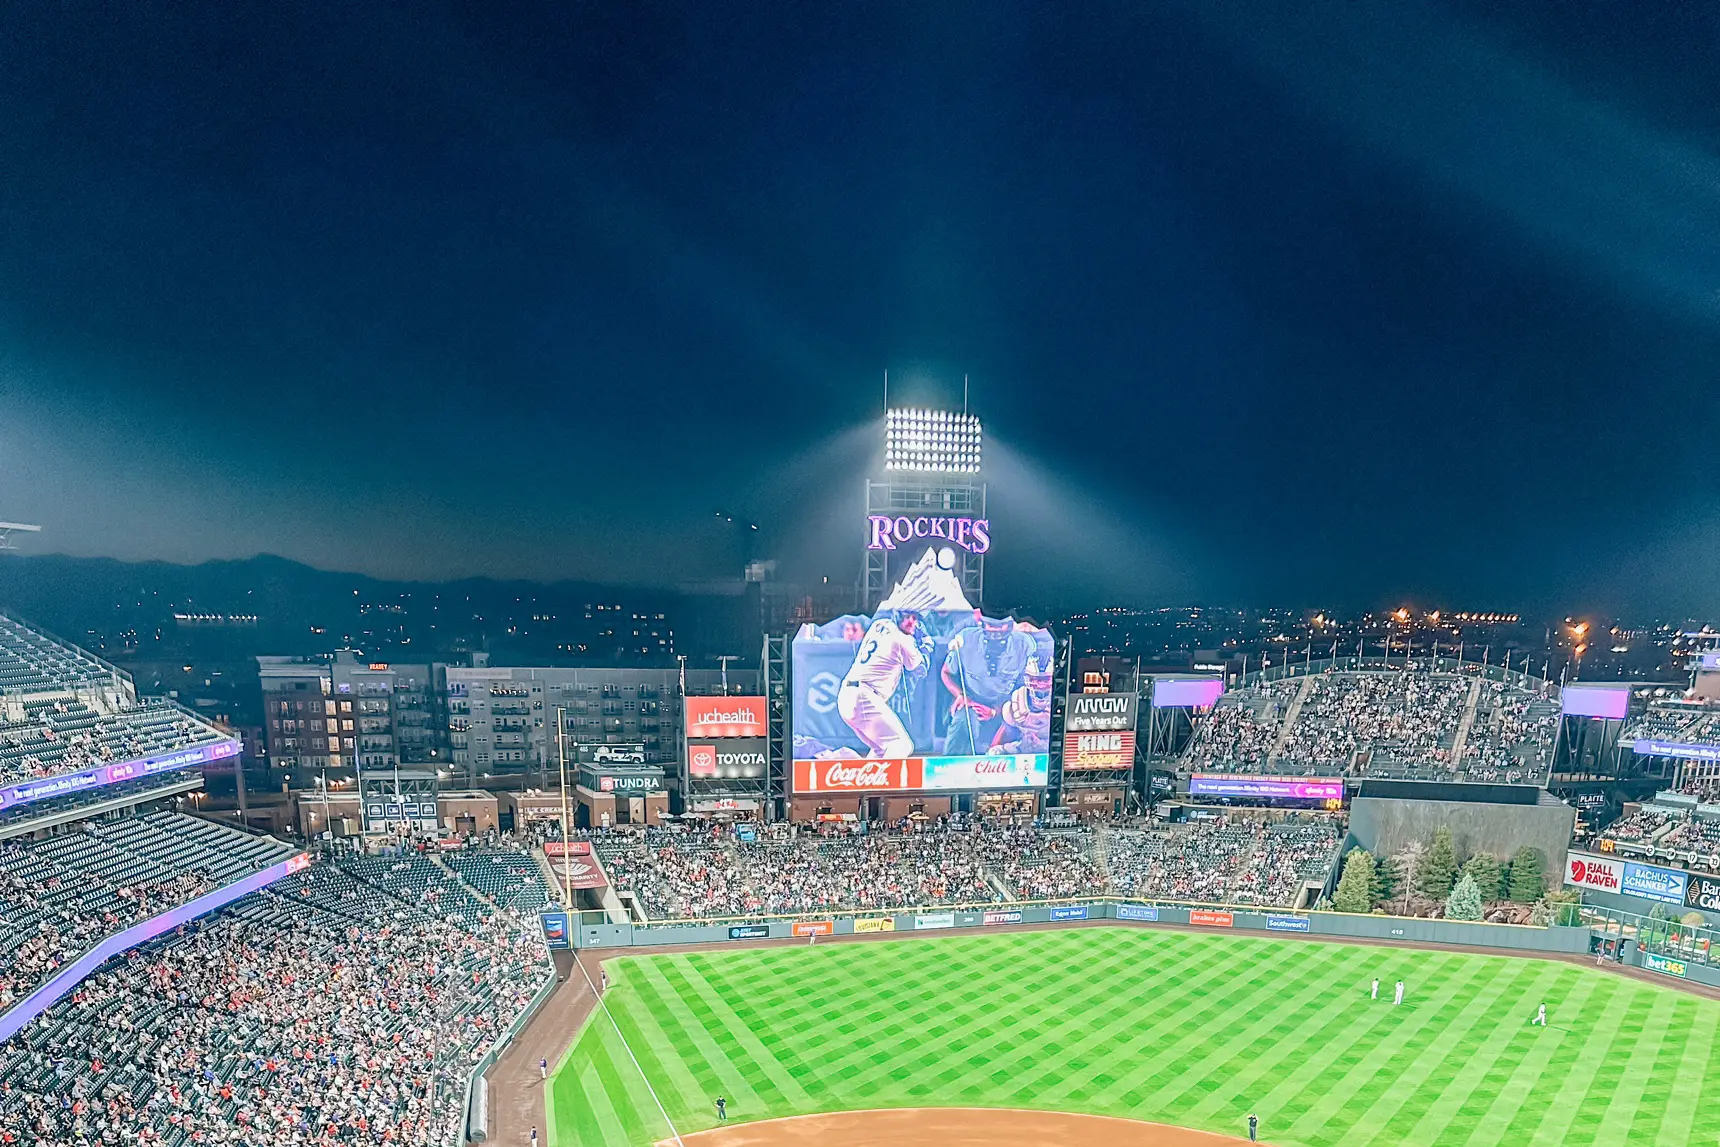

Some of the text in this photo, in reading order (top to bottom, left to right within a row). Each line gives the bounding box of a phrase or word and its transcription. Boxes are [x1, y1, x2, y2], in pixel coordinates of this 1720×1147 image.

[868, 515, 990, 555] ROCKIES
[1074, 697, 1129, 714] ARROW
[698, 708, 755, 724] uchealth
[1074, 716, 1127, 725] Five Years Out
[1077, 735, 1122, 752] KING
[716, 753, 766, 765] TOYOTA
[613, 777, 660, 788] TUNDRA
[1580, 795, 1604, 803] PLATTE
[1587, 863, 1614, 877] FJALL
[1635, 868, 1669, 882] BACHUS
[1585, 874, 1618, 889] RAVEN
[1624, 876, 1668, 893] SCHANKER
[984, 912, 1021, 924] BETFRED
[1192, 914, 1215, 922] brakes
[1268, 919, 1302, 928] Southwest
[1647, 956, 1685, 975] bet365
